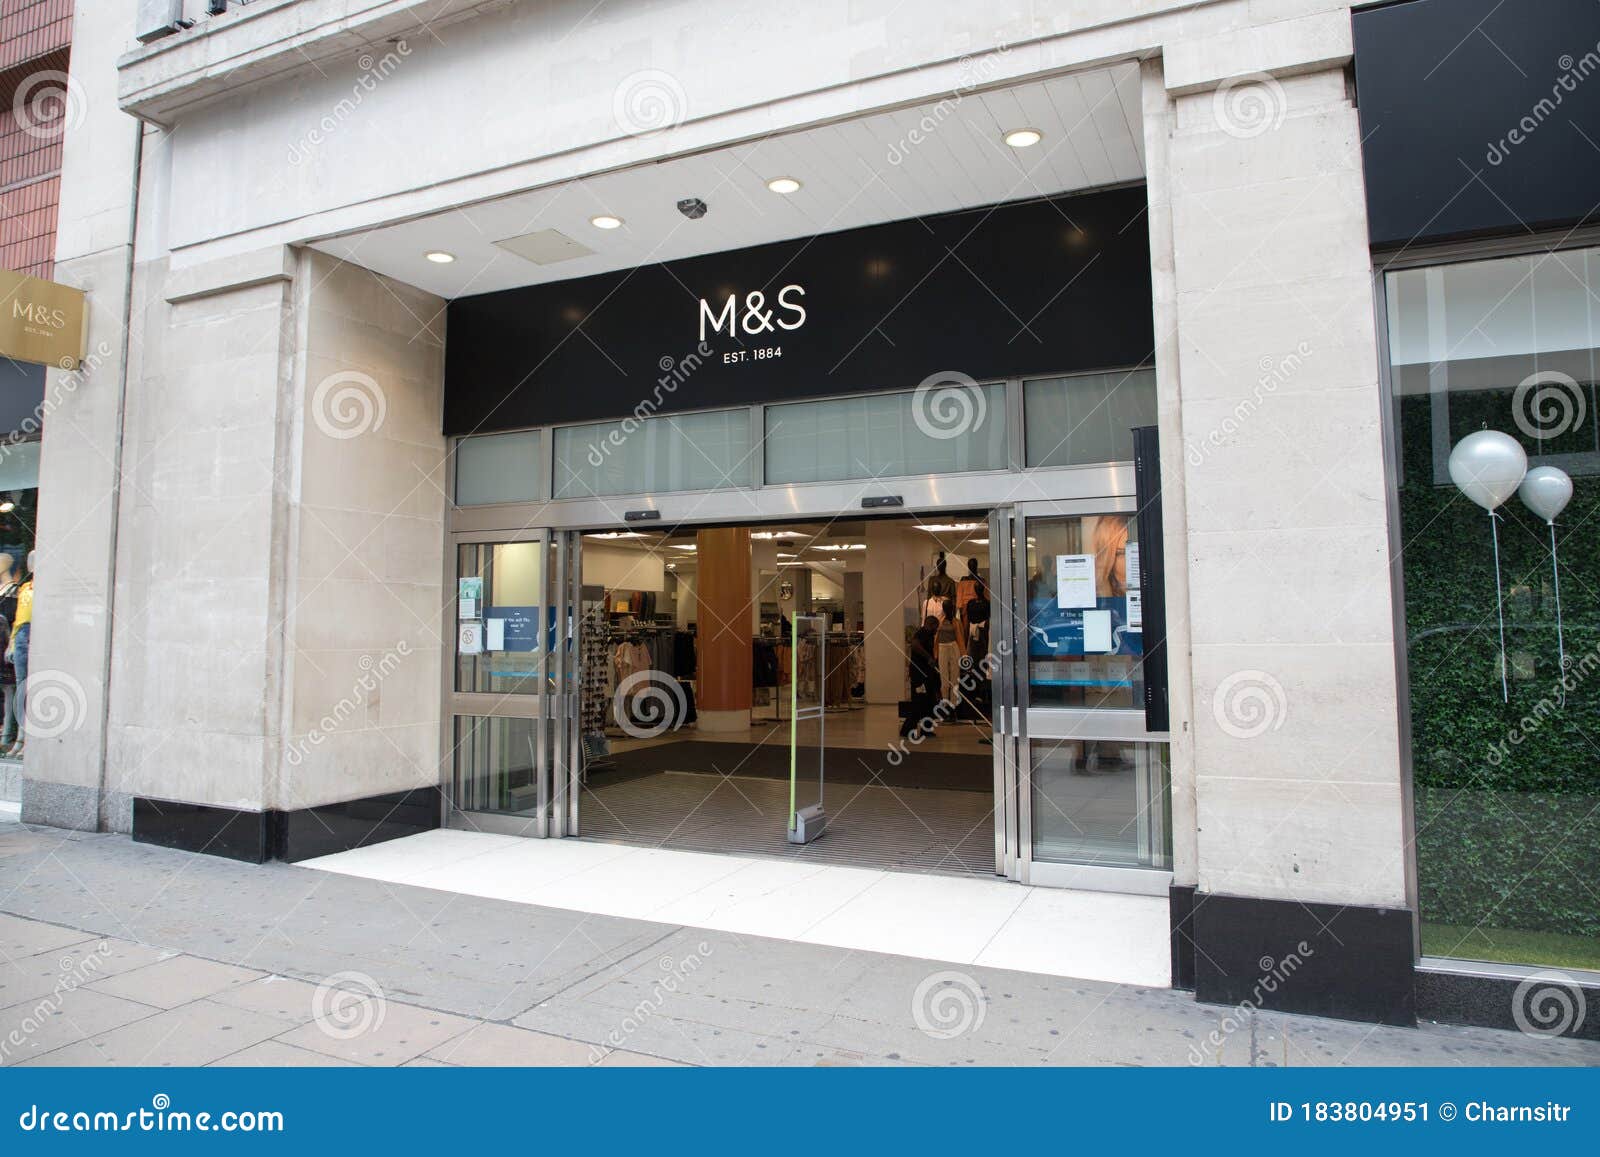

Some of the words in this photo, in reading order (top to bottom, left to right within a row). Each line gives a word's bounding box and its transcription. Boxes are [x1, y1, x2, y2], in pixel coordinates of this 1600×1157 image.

[12, 299, 65, 329] M&S
[699, 284, 806, 341] M&S
[723, 351, 749, 364] EST.
[753, 346, 782, 360] 1884
